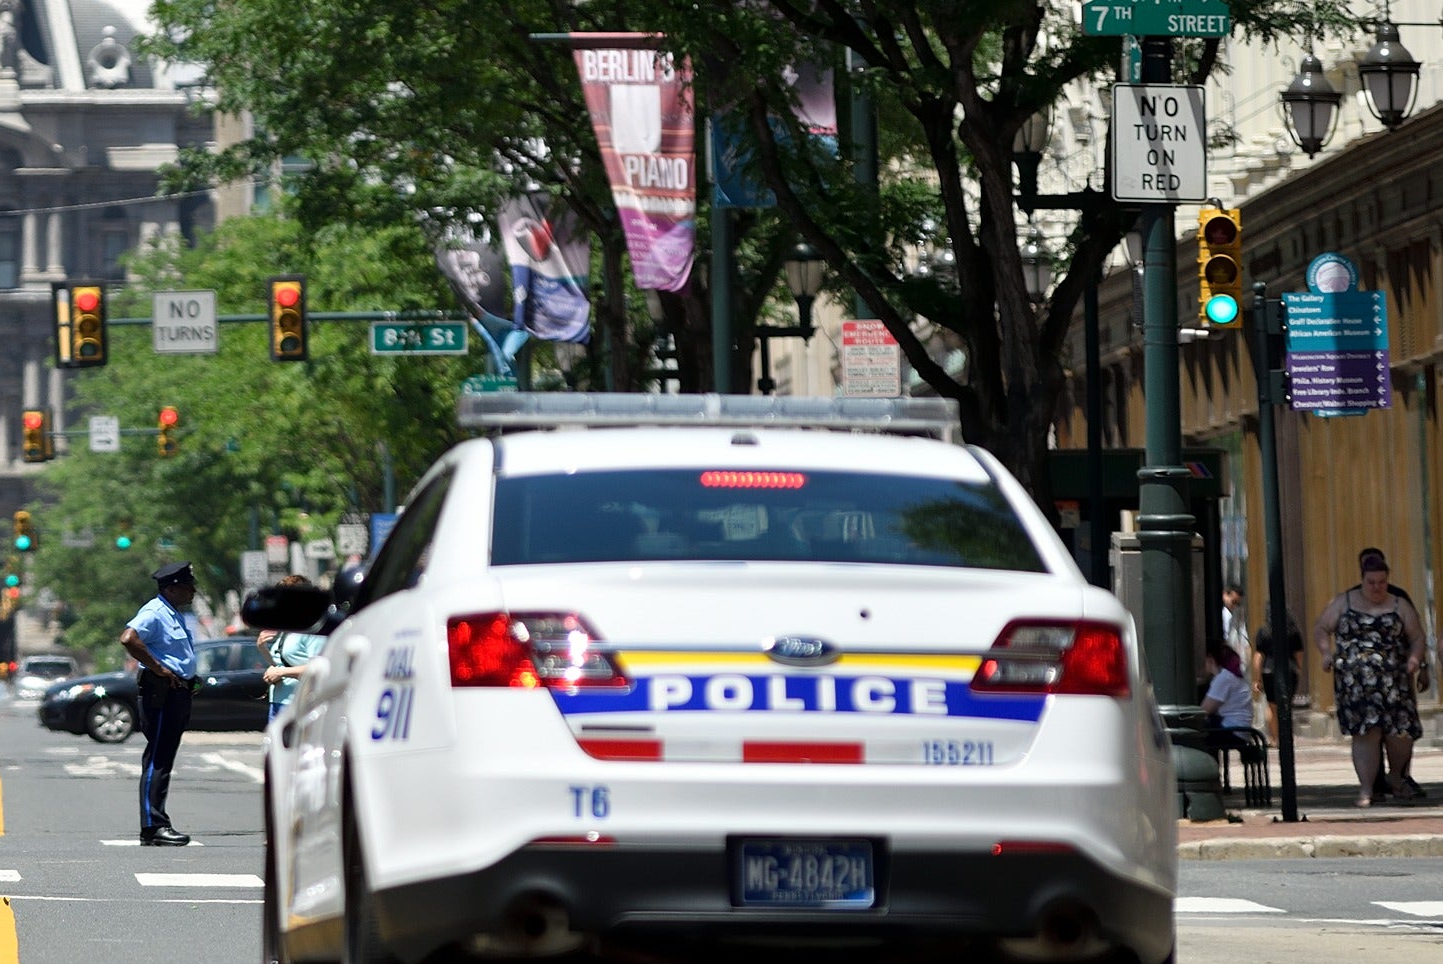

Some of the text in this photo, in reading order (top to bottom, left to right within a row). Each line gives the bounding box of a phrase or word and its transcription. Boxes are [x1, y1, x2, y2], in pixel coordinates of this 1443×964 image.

[1167, 15, 1226, 33] STREET
[582, 49, 676, 82] BERLINS
[1140, 95, 1179, 117] NO
[1133, 124, 1187, 142] TURN
[1147, 149, 1175, 166] ON
[624, 154, 689, 191] PIANO
[1141, 173, 1181, 191] RED
[168, 298, 201, 319] NO
[157, 325, 214, 342] TURNS
[429, 327, 456, 346] St
[844, 330, 894, 338] EMERGENC
[649, 673, 950, 716] POLICE
[370, 685, 415, 741] 911
[922, 740, 995, 766] 155211
[569, 786, 612, 819] T6
[748, 854, 867, 891] MG-4842H
